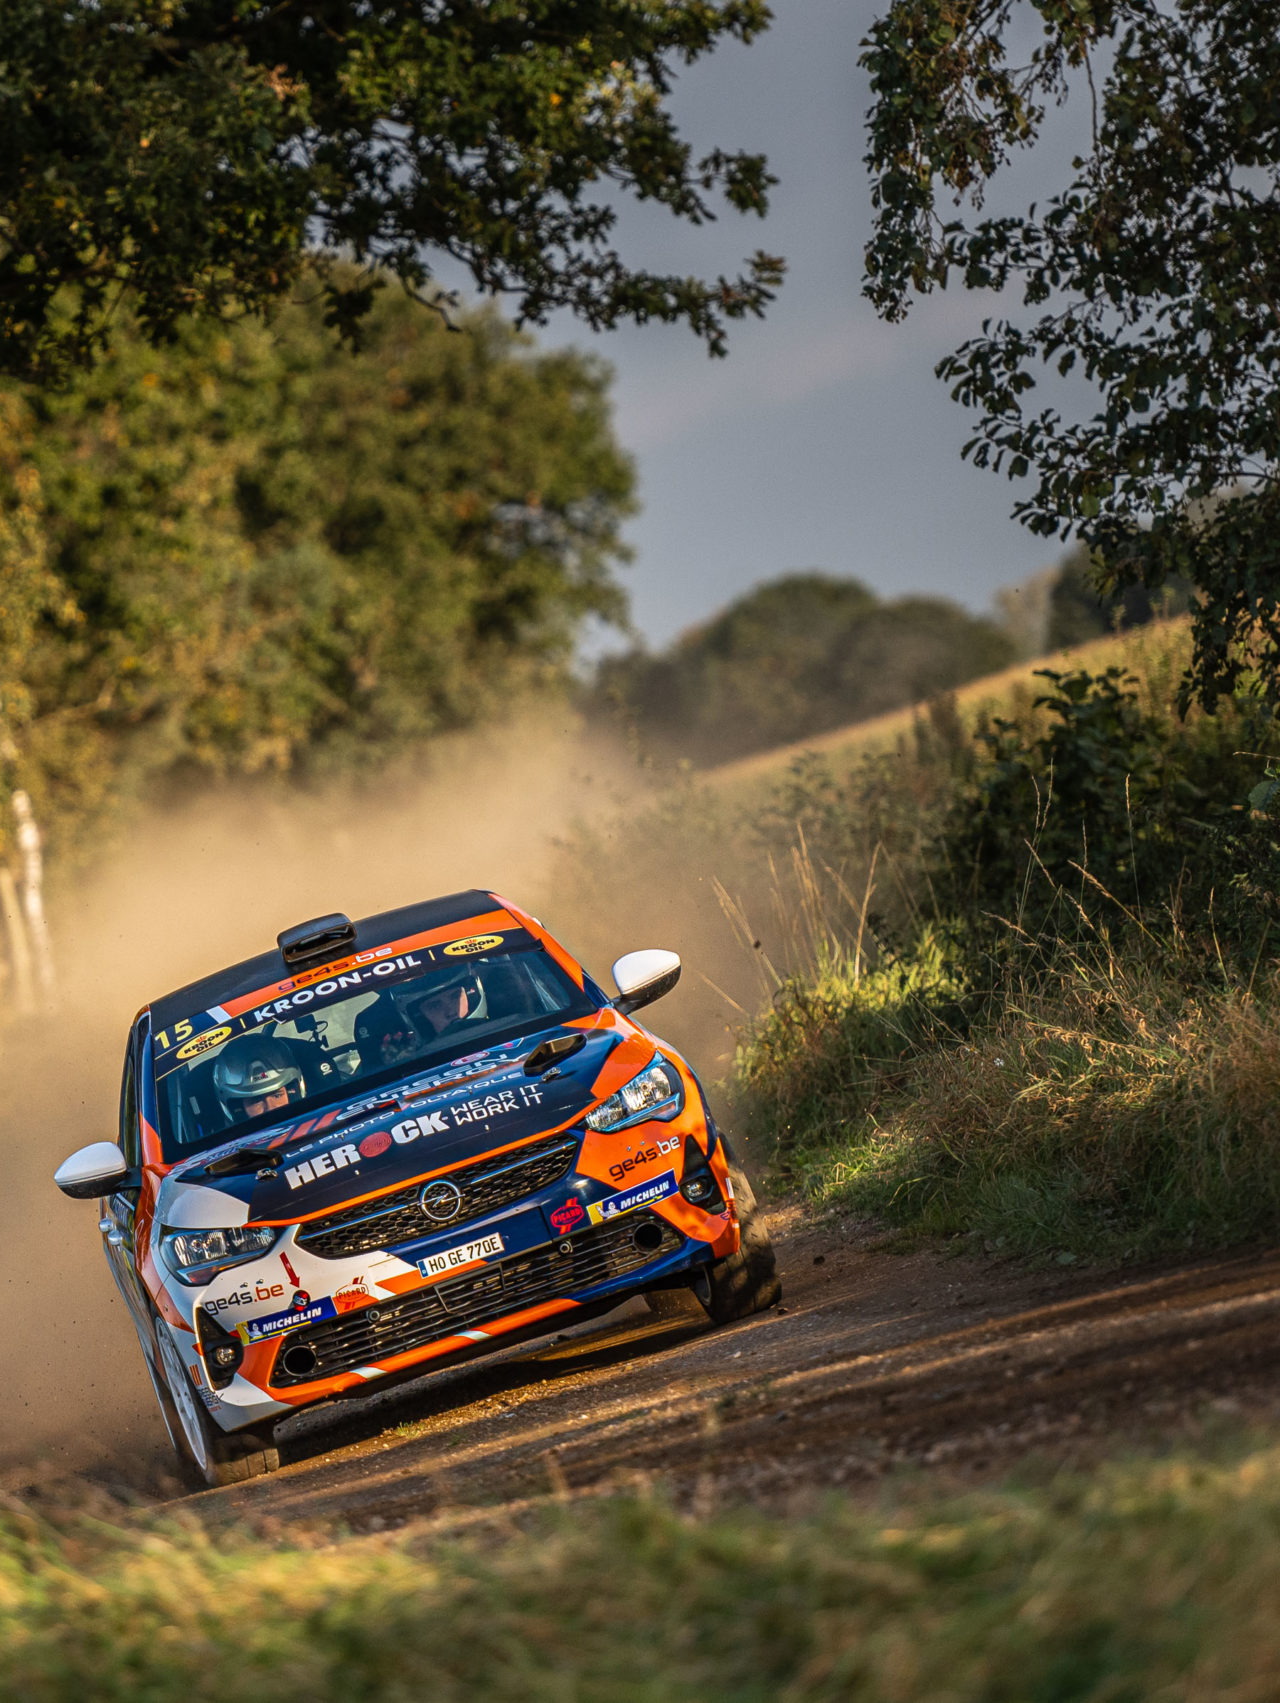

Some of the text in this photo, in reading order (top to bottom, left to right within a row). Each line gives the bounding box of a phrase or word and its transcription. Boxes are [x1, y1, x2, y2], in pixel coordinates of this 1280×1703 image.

[452, 938, 495, 952] KROON
[465, 945, 485, 953] OIL
[277, 947, 393, 993] ge4s.be
[253, 955, 422, 1023] KROON-OIL
[154, 1018, 193, 1049] 15
[183, 1030, 224, 1054] KROON
[196, 1041, 215, 1053] OIL
[450, 1083, 539, 1115] WEAR IT
[454, 1092, 544, 1126] WORK IT
[608, 1135, 681, 1182] ge4s.be
[620, 1180, 670, 1210] MICHELIN
[428, 1236, 500, 1273] HO GE 770E
[204, 1284, 285, 1316] ge4s.be
[262, 1306, 322, 1333] MICHELIN
